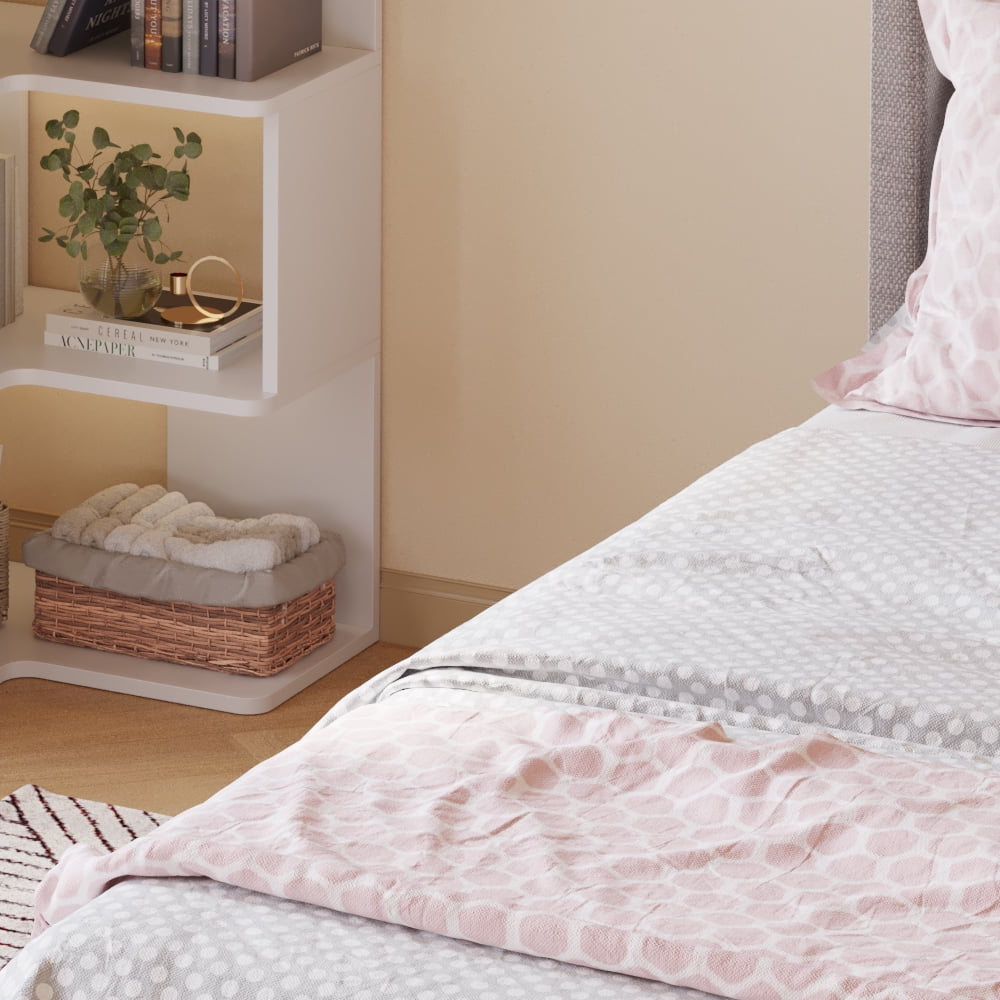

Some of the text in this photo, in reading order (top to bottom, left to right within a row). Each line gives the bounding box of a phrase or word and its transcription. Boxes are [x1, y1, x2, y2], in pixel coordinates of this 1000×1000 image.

[149, 15, 158, 35] YOU
[98, 325, 144, 343] CEREAL
[169, 339, 190, 347] YORK
